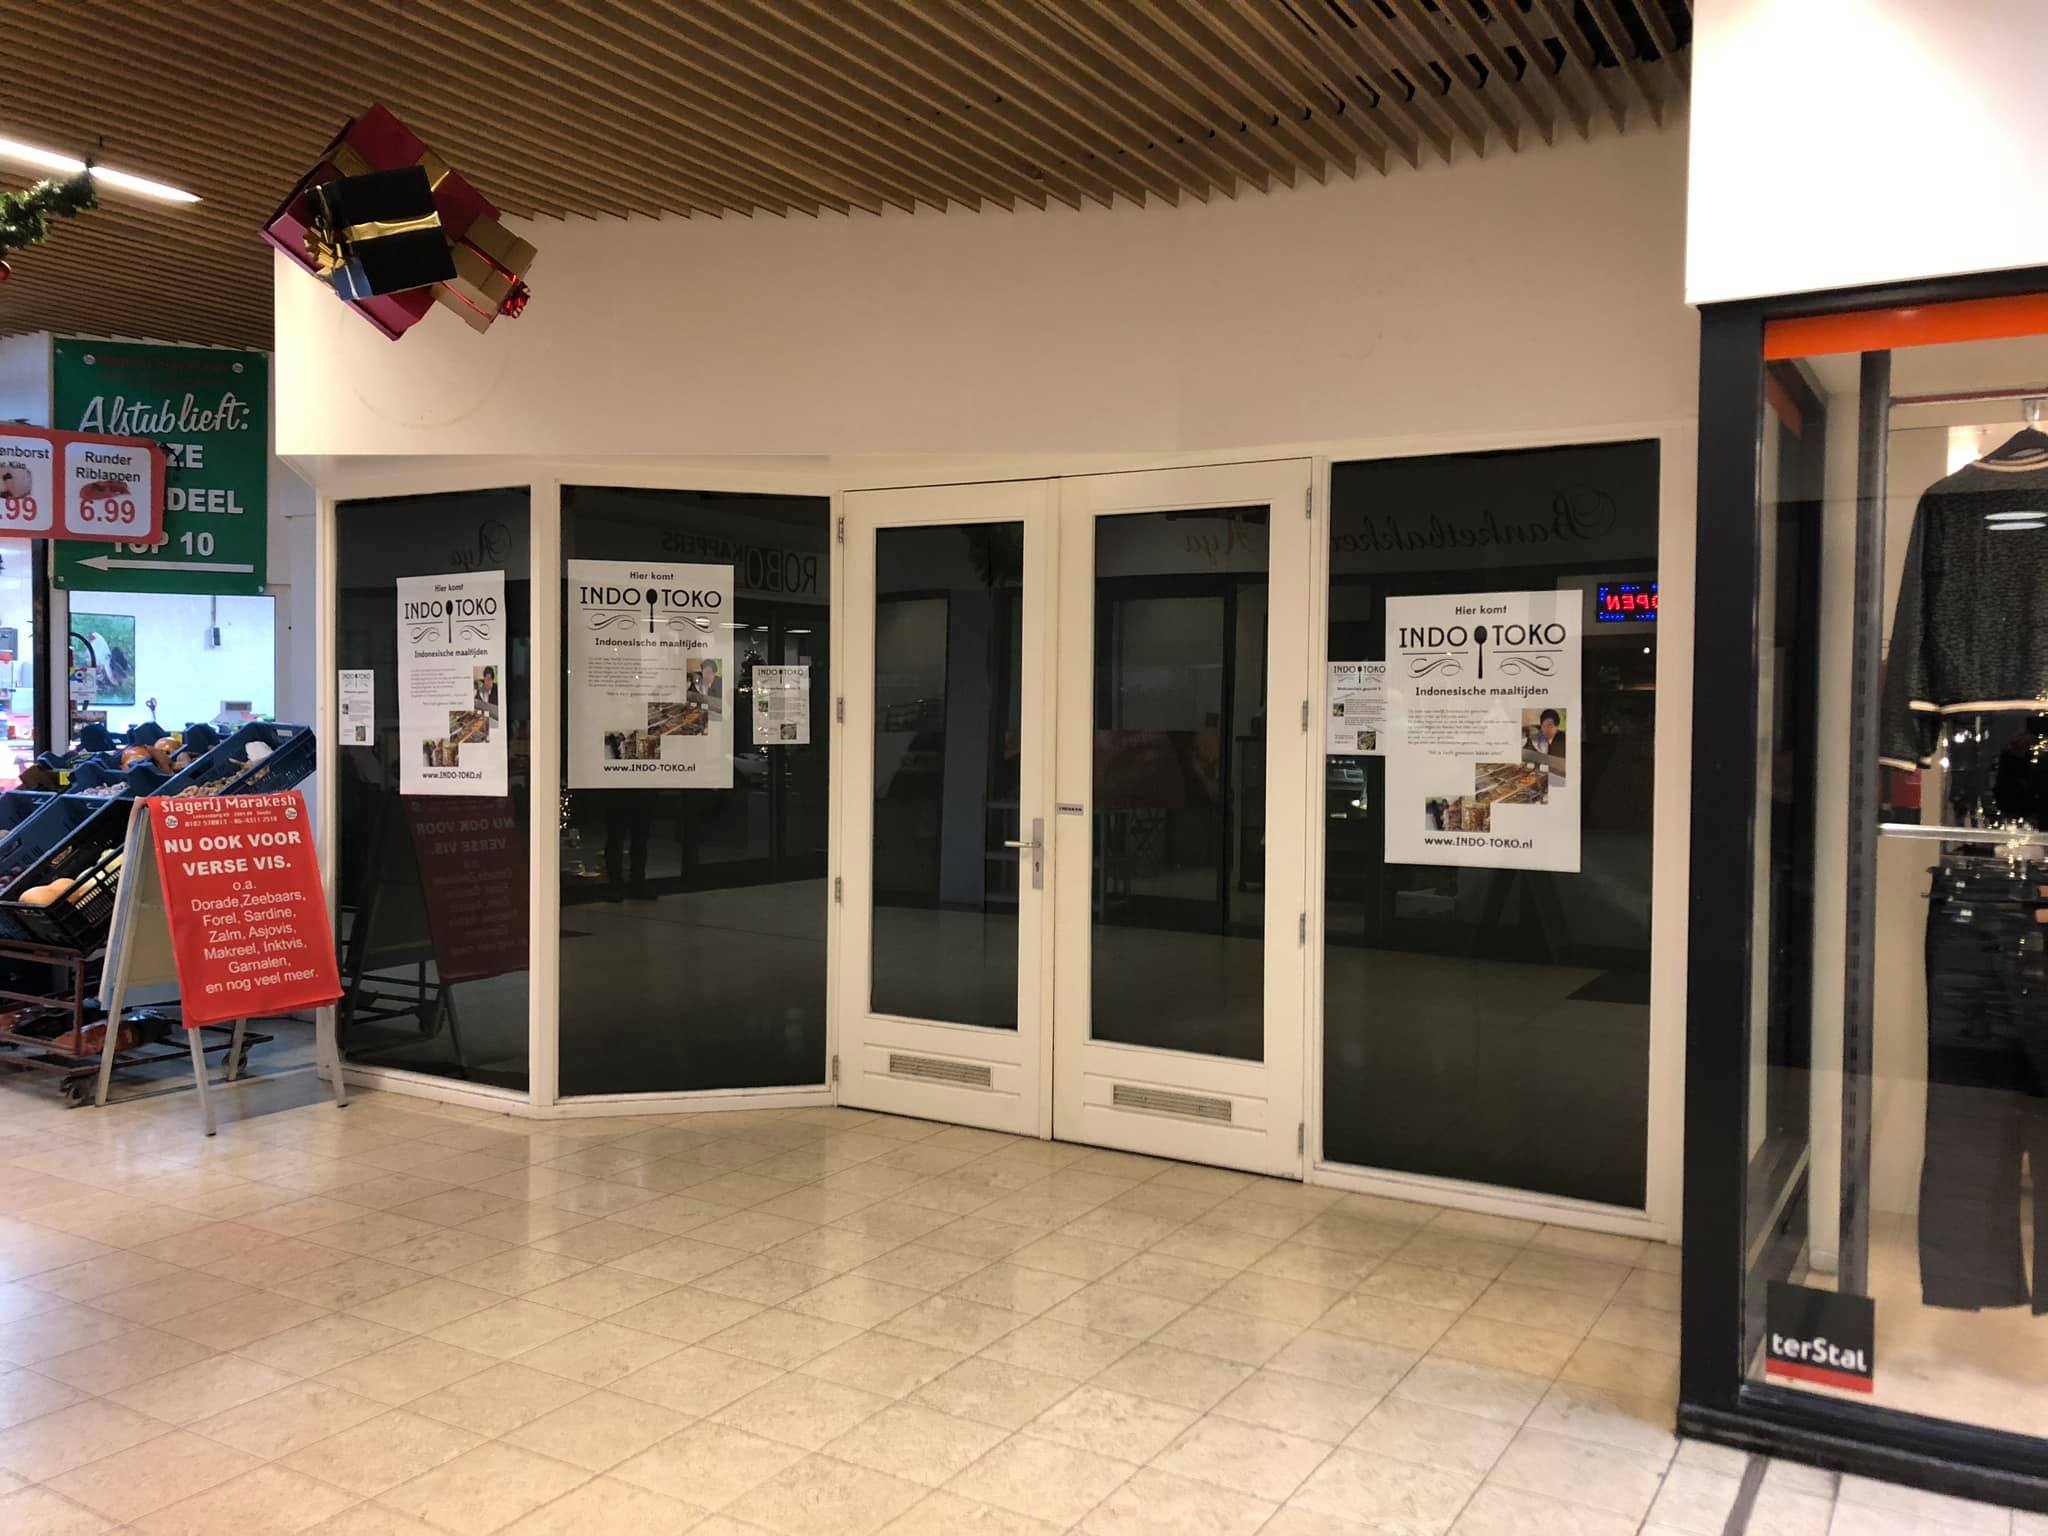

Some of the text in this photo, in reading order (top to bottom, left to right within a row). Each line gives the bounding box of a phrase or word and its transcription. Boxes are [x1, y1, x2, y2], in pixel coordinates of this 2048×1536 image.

[78, 391, 251, 436] Alstublieft:
[85, 451, 132, 465] Runder
[157, 443, 203, 468] ZE
[75, 467, 141, 482] Riblappen
[80, 499, 136, 524] 6.99
[164, 487, 244, 514] DEEL
[180, 531, 214, 556] 10
[629, 571, 674, 581] Hier komt
[404, 597, 497, 619] INDO TOKO
[580, 586, 722, 608] INDO TOKO
[1455, 604, 1507, 615] Hier komt
[595, 637, 708, 650] Indonesische maaltijden
[1399, 623, 1566, 648] INDO TOKO
[1415, 685, 1549, 698] Indonesische maaltijden
[603, 763, 696, 772] www.INDO-TOKO.nl
[161, 798, 221, 815] Slagerij
[225, 795, 296, 809] Marakesh
[164, 831, 302, 854] NU OOK VOOR
[1424, 836, 1533, 849] www.INDO-TOKO.nl
[182, 855, 292, 877] VERSE VIS.
[232, 880, 257, 891] o.a.
[205, 969, 319, 993] en nog veel meer.
[1772, 1332, 1867, 1372] terStal
